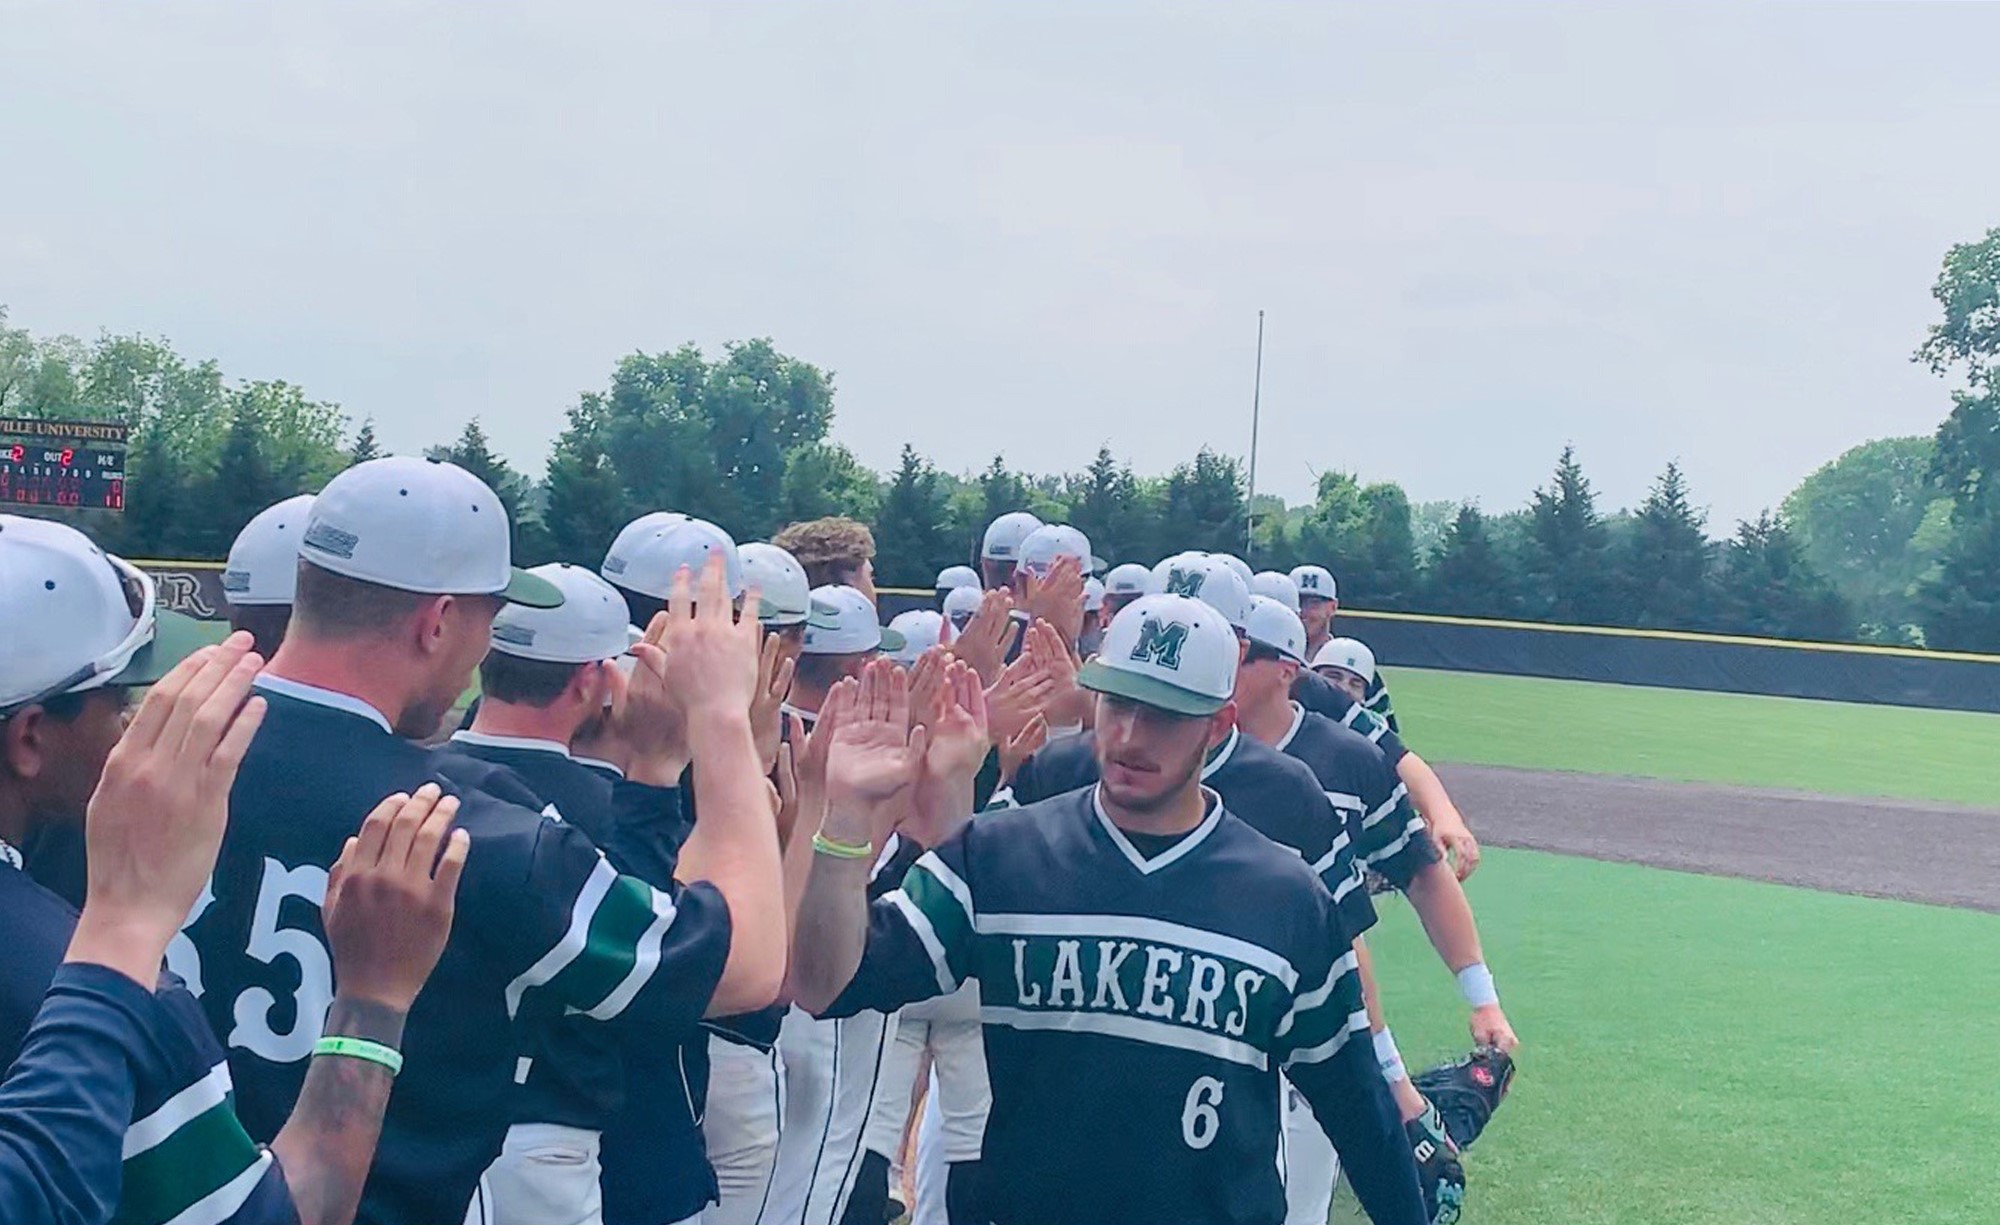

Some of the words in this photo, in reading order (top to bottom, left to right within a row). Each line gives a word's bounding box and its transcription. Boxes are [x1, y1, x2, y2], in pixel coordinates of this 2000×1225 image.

[36, 422, 125, 439] UNIVERSITY
[44, 451, 63, 462] OUT
[62, 449, 73, 466] 2
[1163, 567, 1208, 599] M
[1301, 574, 1318, 588] M
[1130, 617, 1190, 671] M
[1011, 938, 1266, 1037] LAKERS
[1181, 1075, 1225, 1150] 6
